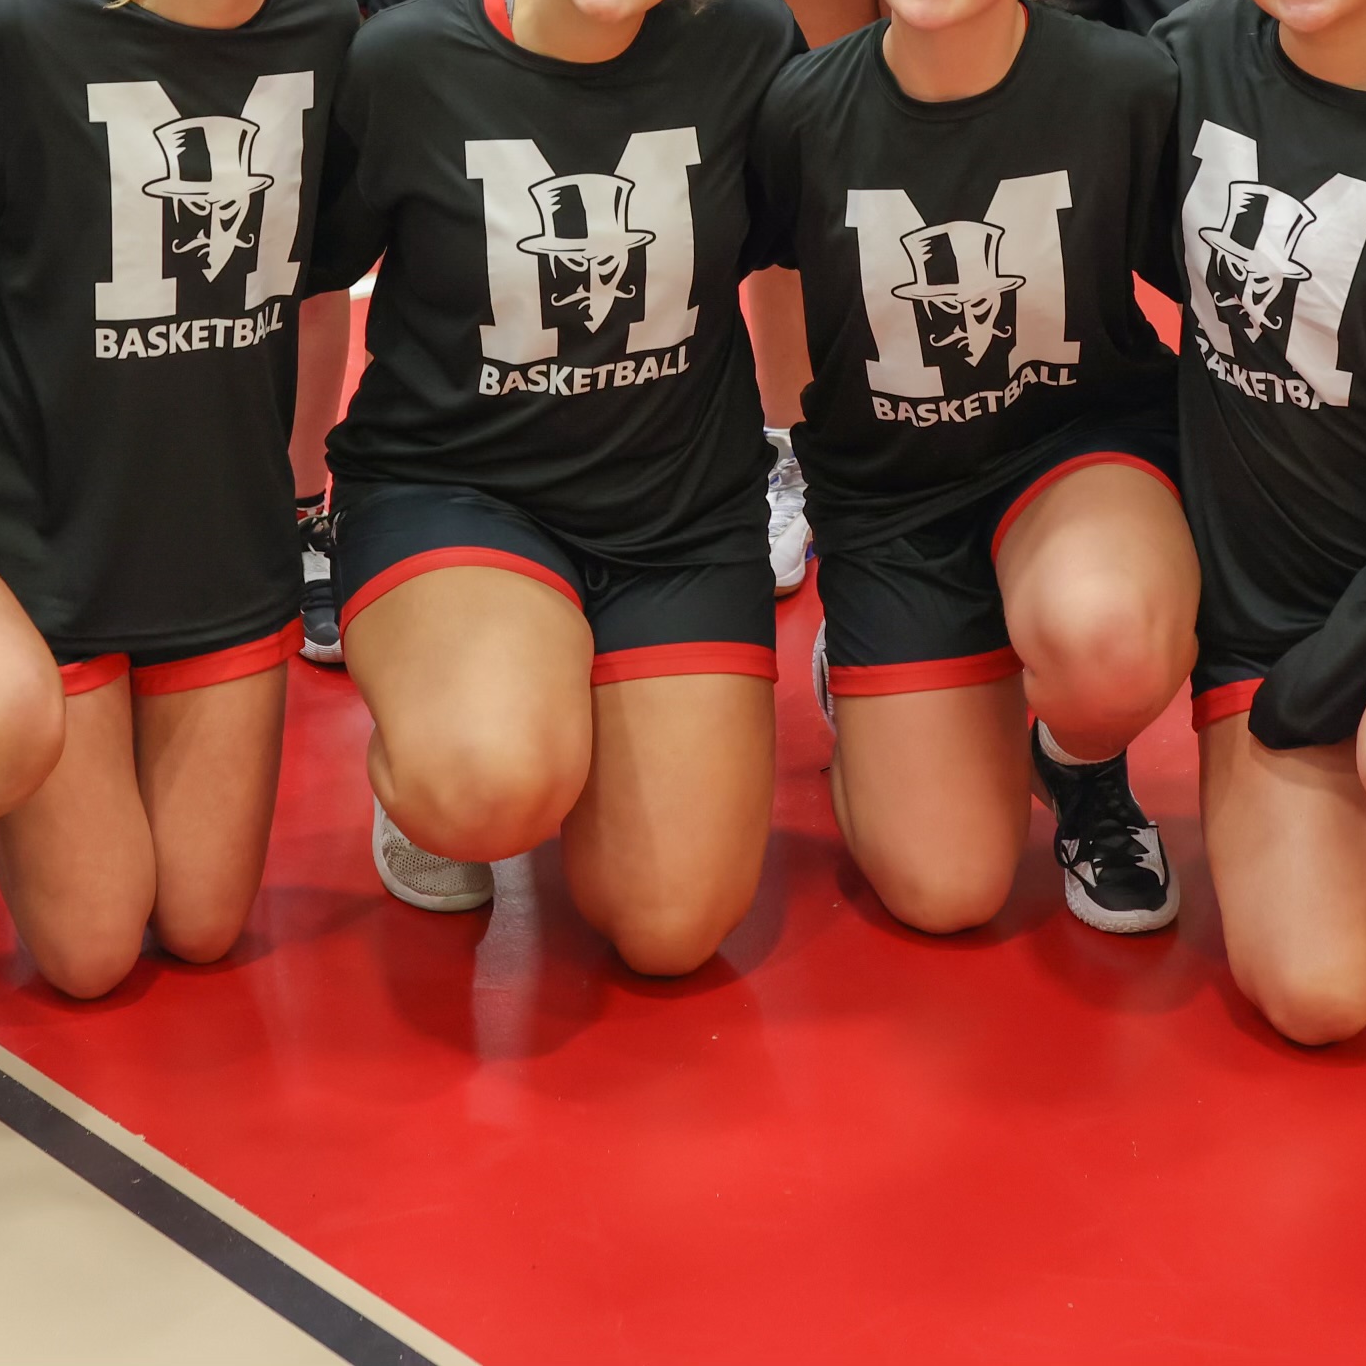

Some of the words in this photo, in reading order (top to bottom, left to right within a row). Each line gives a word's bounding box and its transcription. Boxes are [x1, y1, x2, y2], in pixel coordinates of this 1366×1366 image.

[94, 299, 283, 361] BASKETBALL
[478, 345, 690, 398] BASKETBALL
[873, 361, 1078, 429] BASKETBALL
